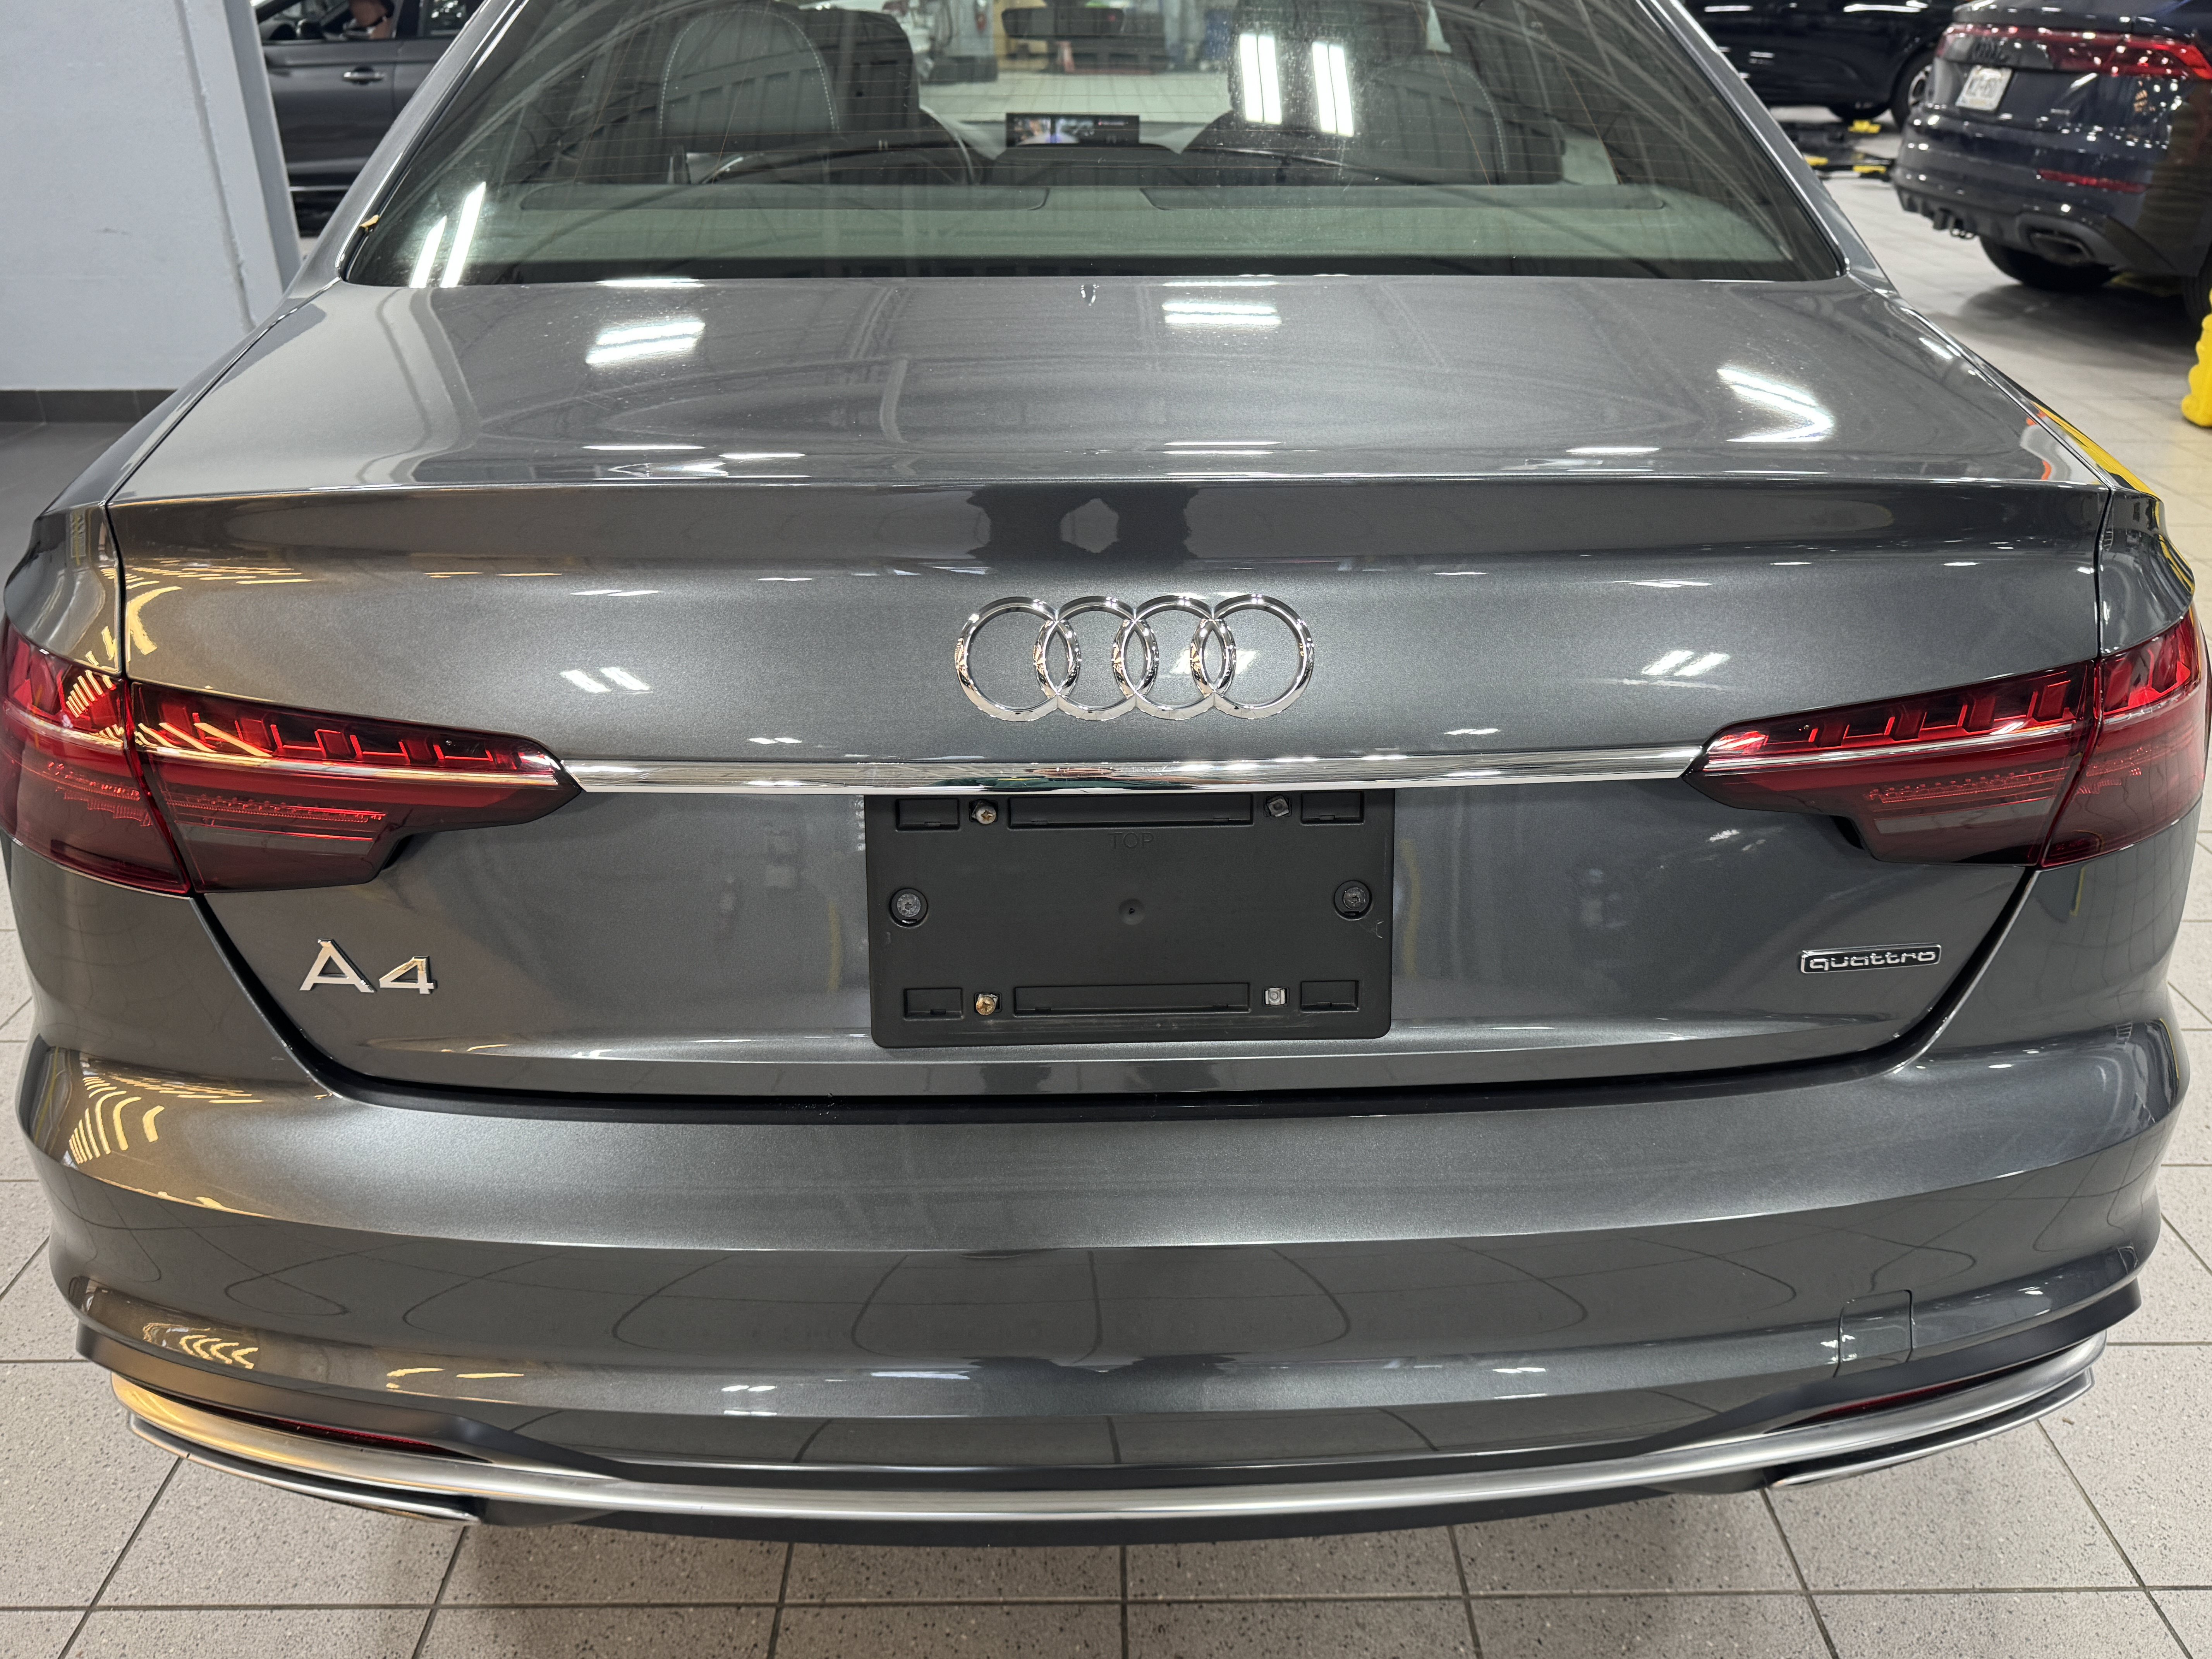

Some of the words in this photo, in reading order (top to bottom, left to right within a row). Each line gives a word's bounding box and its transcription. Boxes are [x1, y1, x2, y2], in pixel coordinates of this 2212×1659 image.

[1108, 831, 1154, 849] TOP
[299, 938, 437, 994] A4
[1810, 951, 1936, 971] quattro
